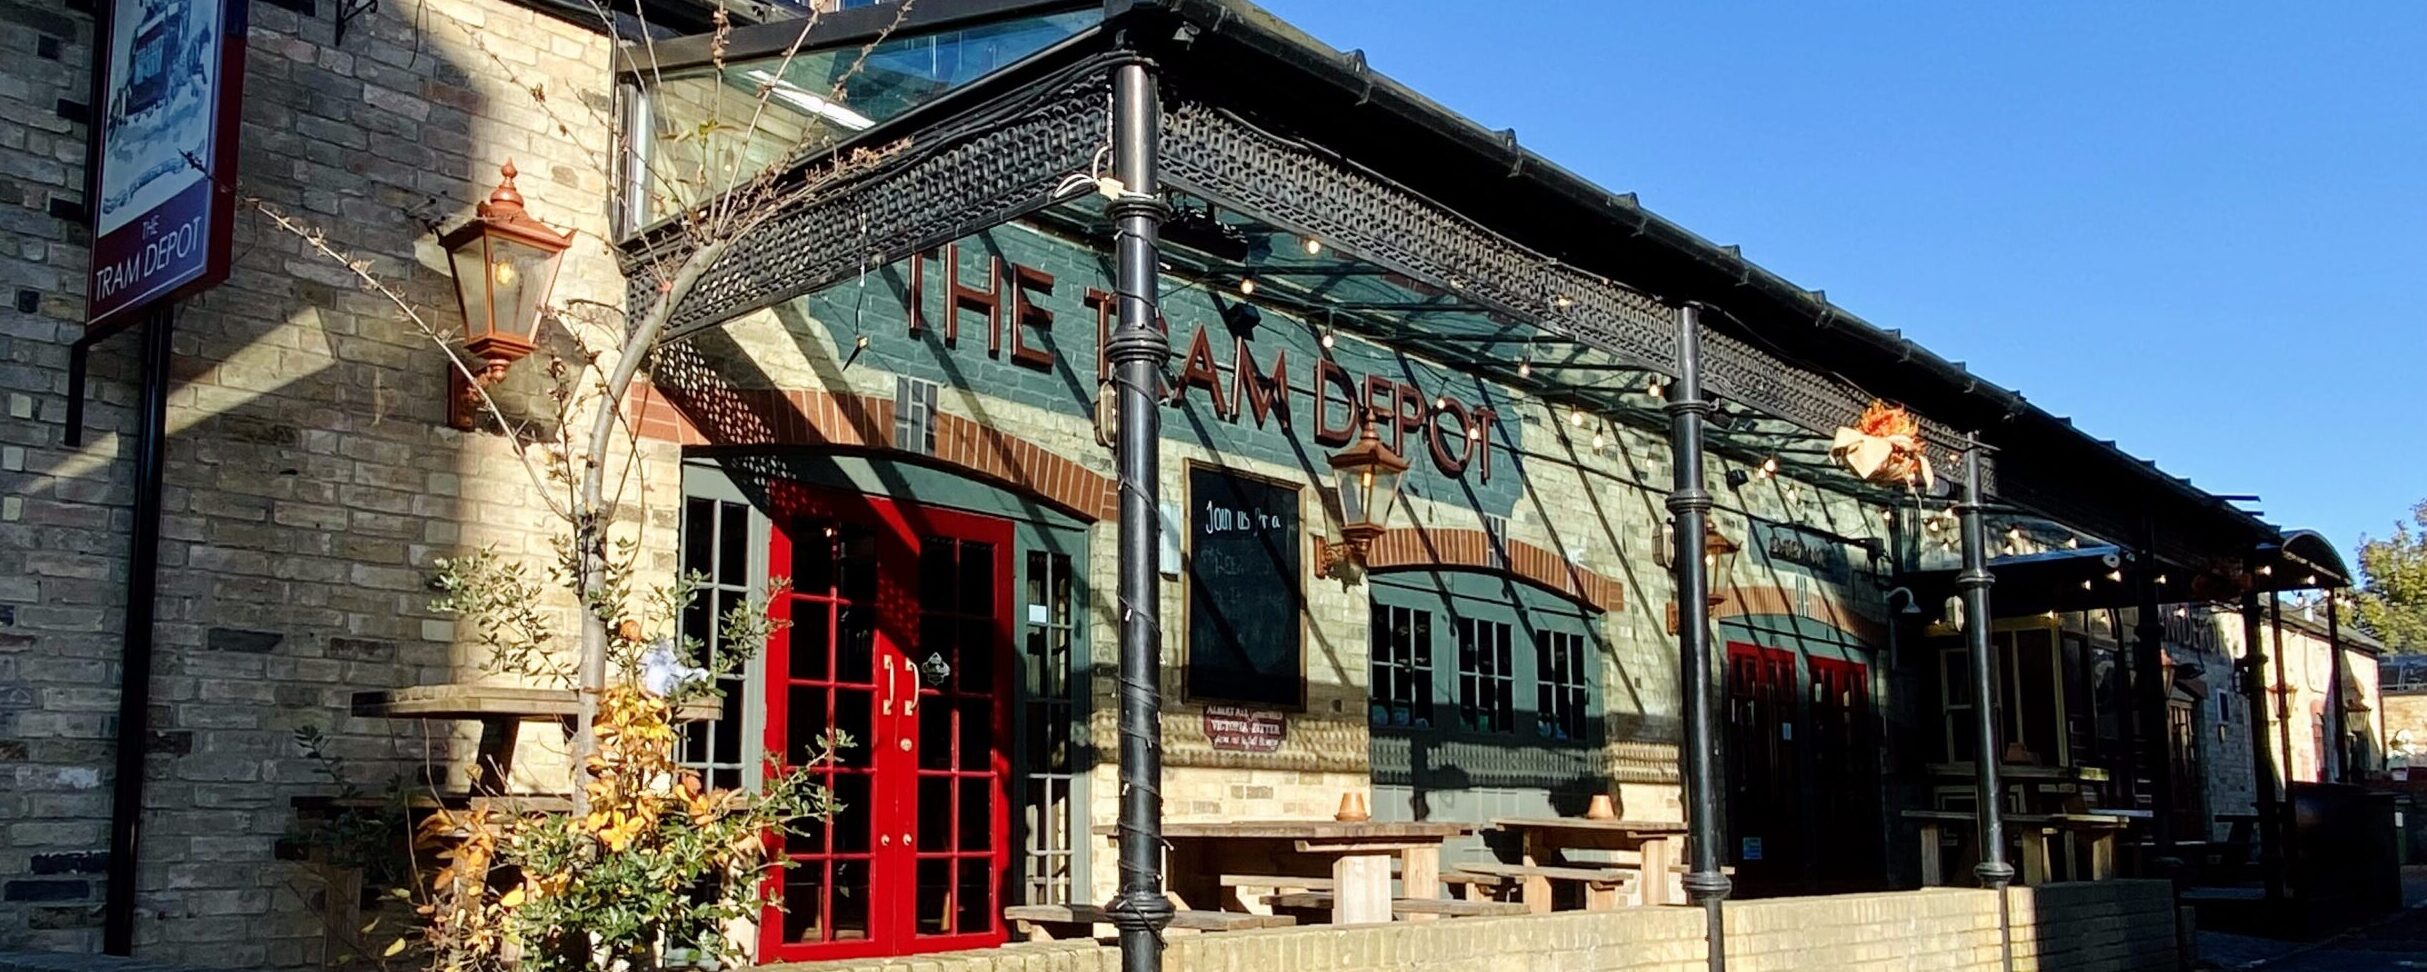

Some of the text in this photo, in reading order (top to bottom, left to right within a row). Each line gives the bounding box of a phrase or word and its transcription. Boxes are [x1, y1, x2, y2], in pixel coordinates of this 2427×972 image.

[142, 214, 160, 240] THE
[96, 216, 202, 302] TRAM DEPOT
[909, 242, 1054, 373] THE
[1084, 286, 1289, 433] TAM
[1206, 500, 1232, 534] Join
